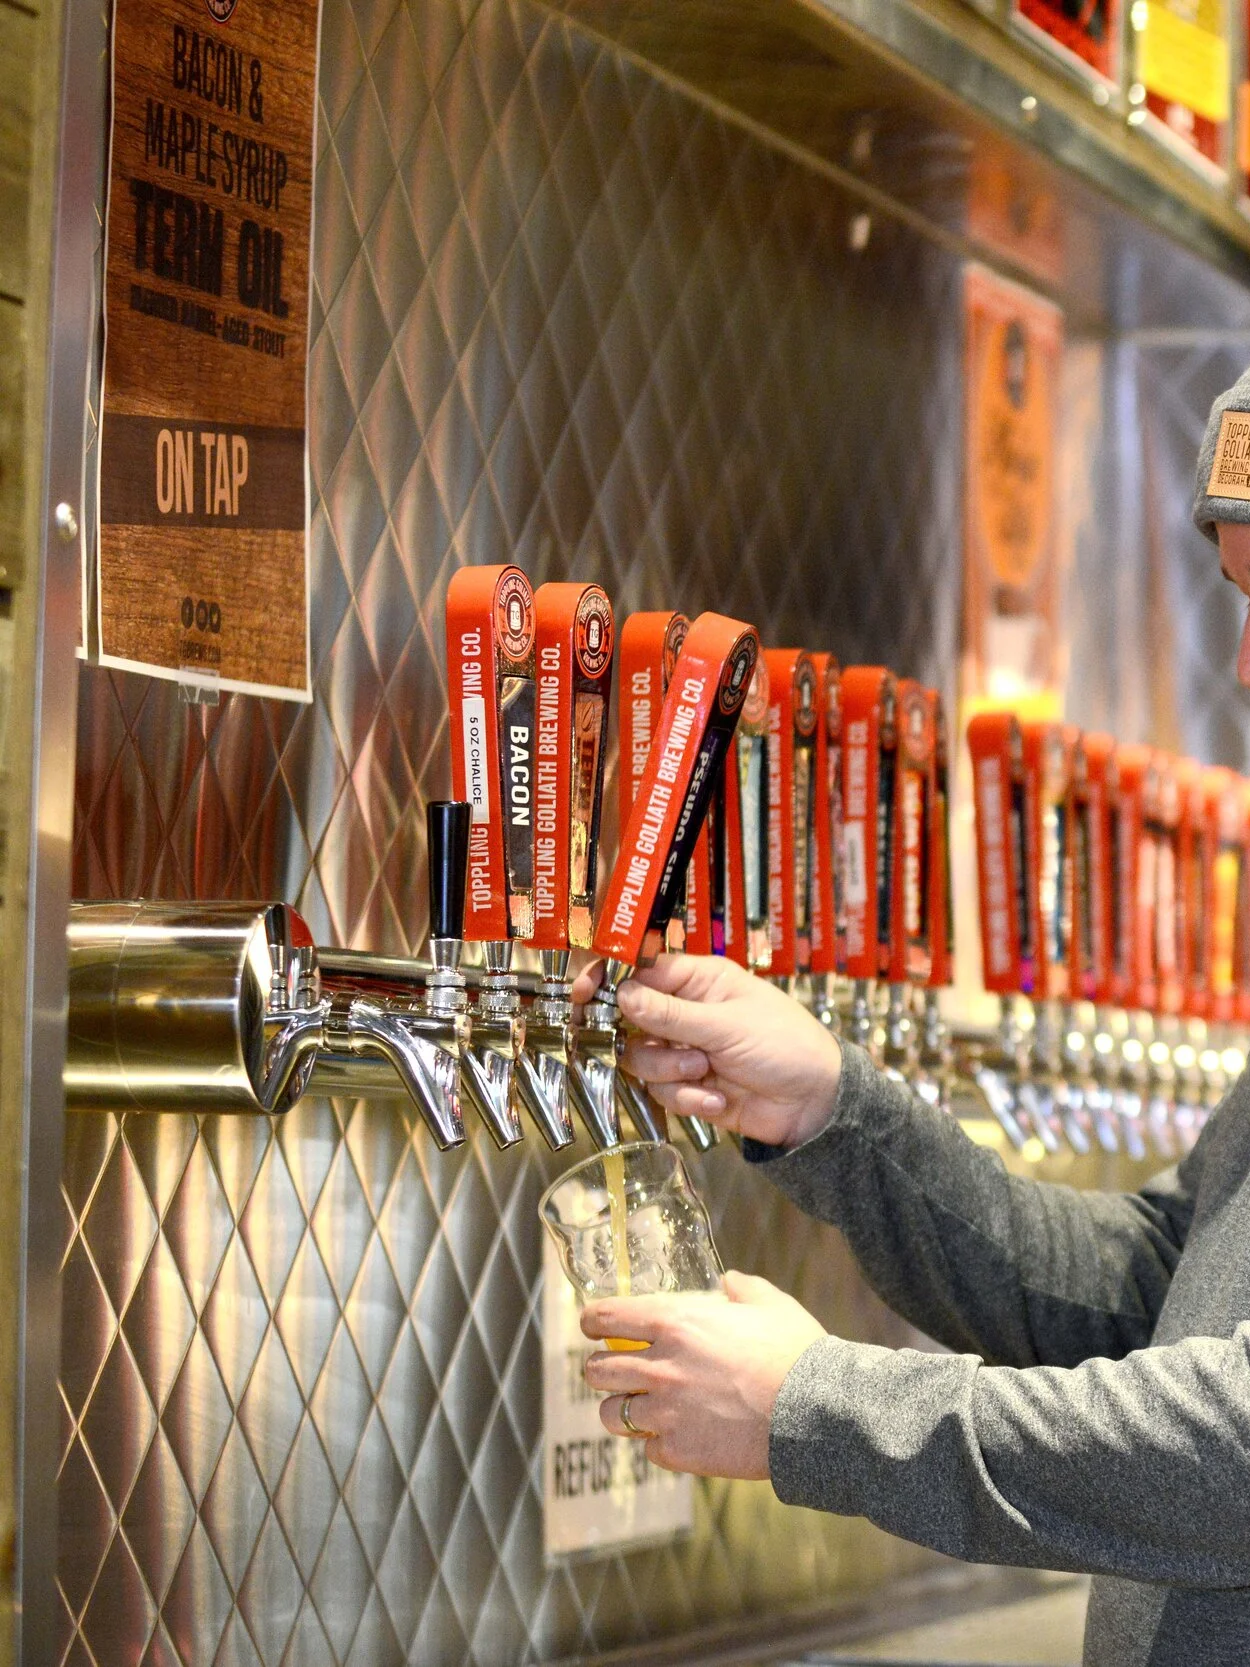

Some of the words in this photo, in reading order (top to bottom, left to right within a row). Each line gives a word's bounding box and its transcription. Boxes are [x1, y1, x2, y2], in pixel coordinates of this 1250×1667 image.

[173, 24, 242, 116] BACON
[250, 59, 263, 124] &
[145, 98, 217, 187] MAPLE
[222, 130, 287, 212] SYRUP
[238, 219, 288, 319] OIL
[156, 428, 194, 514] ON
[200, 432, 249, 516] TAP
[1220, 459, 1250, 473] BREWING
[461, 627, 481, 656] CO.
[541, 642, 560, 670] CO.
[632, 667, 651, 695] CO.
[470, 727, 480, 745] OZ
[539, 676, 559, 755] BREWING
[471, 749, 482, 805] CHALICE
[510, 725, 530, 826] BACON
[537, 761, 557, 832] GOLIATH
[610, 855, 650, 935] TOPPLING
[636, 784, 672, 855] GOLIATH
[657, 705, 695, 783] BREWING
[681, 677, 706, 704] CO.
[470, 827, 491, 912] TOPPLING
[536, 837, 556, 920] TOPPLING
